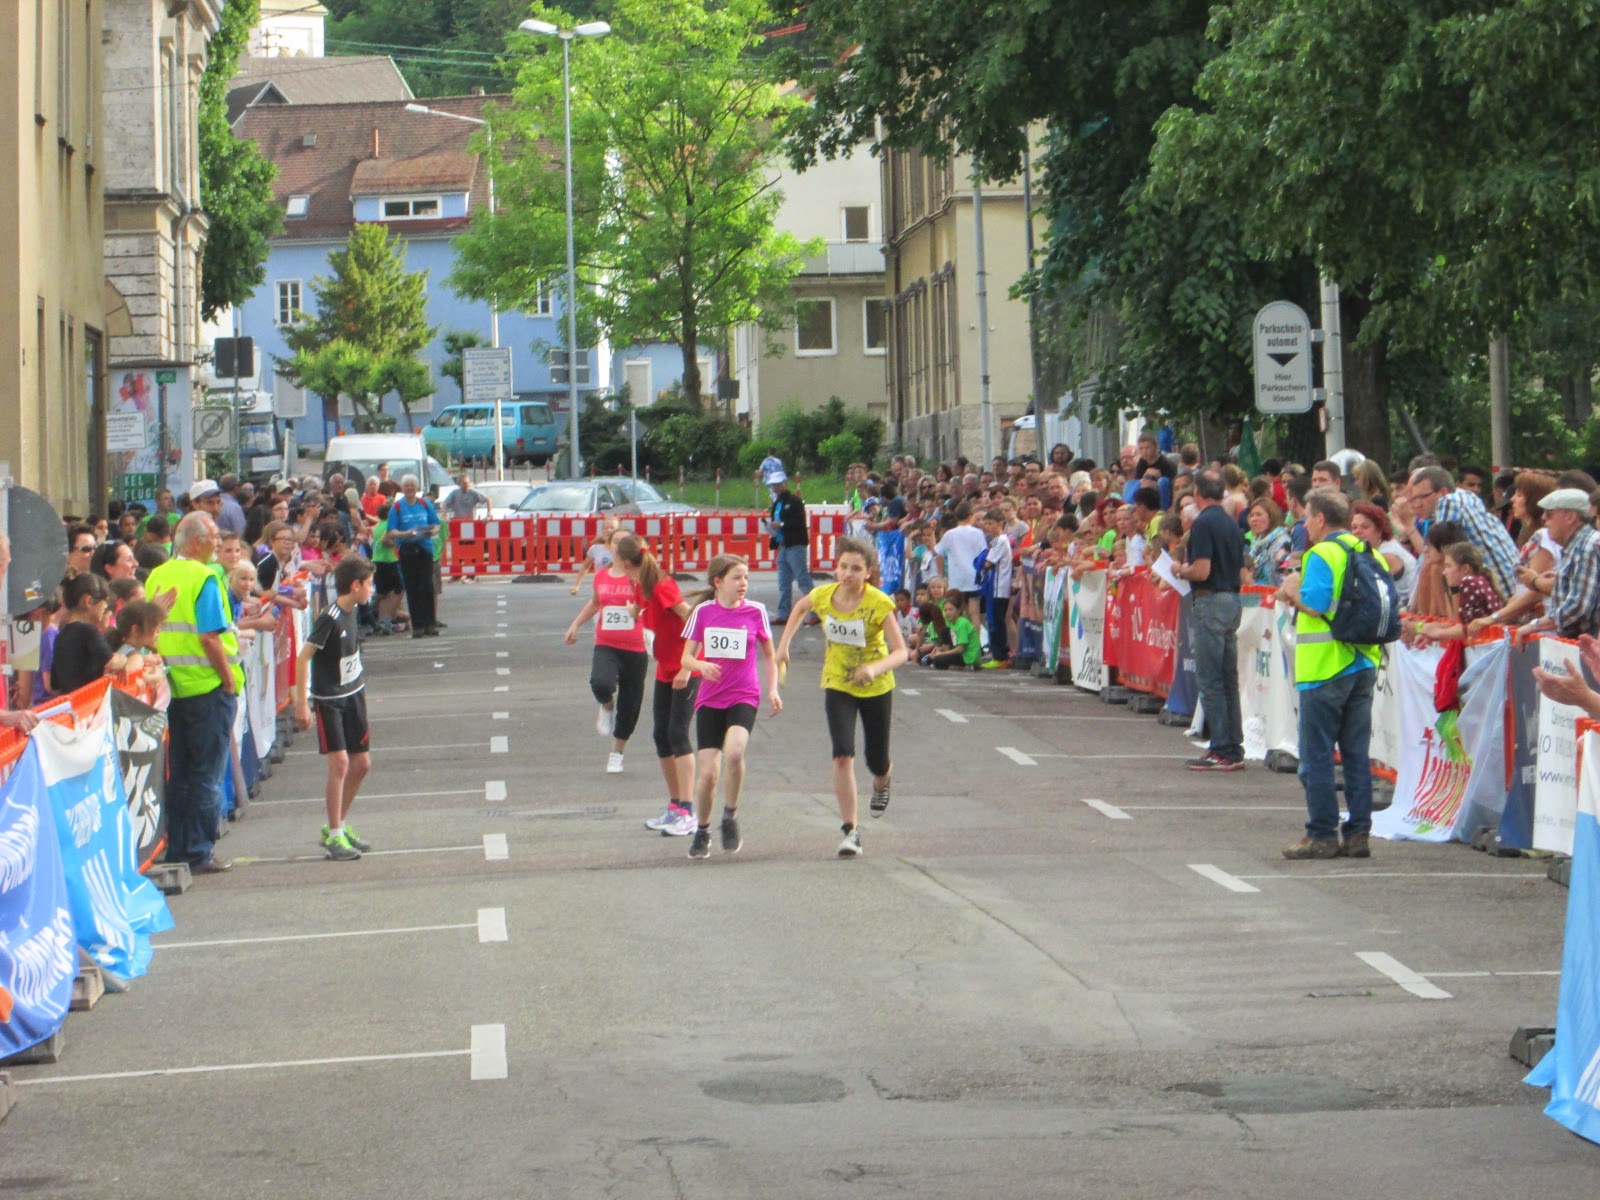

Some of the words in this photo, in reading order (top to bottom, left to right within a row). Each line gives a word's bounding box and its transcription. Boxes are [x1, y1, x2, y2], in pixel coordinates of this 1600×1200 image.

[1259, 323, 1305, 334] Parkschein-
[1266, 336, 1298, 347] automat
[1274, 373, 1292, 381] Hier
[1260, 383, 1307, 392] Parkschein
[1272, 394, 1296, 403] lösen
[710, 635, 740, 651] 30.3
